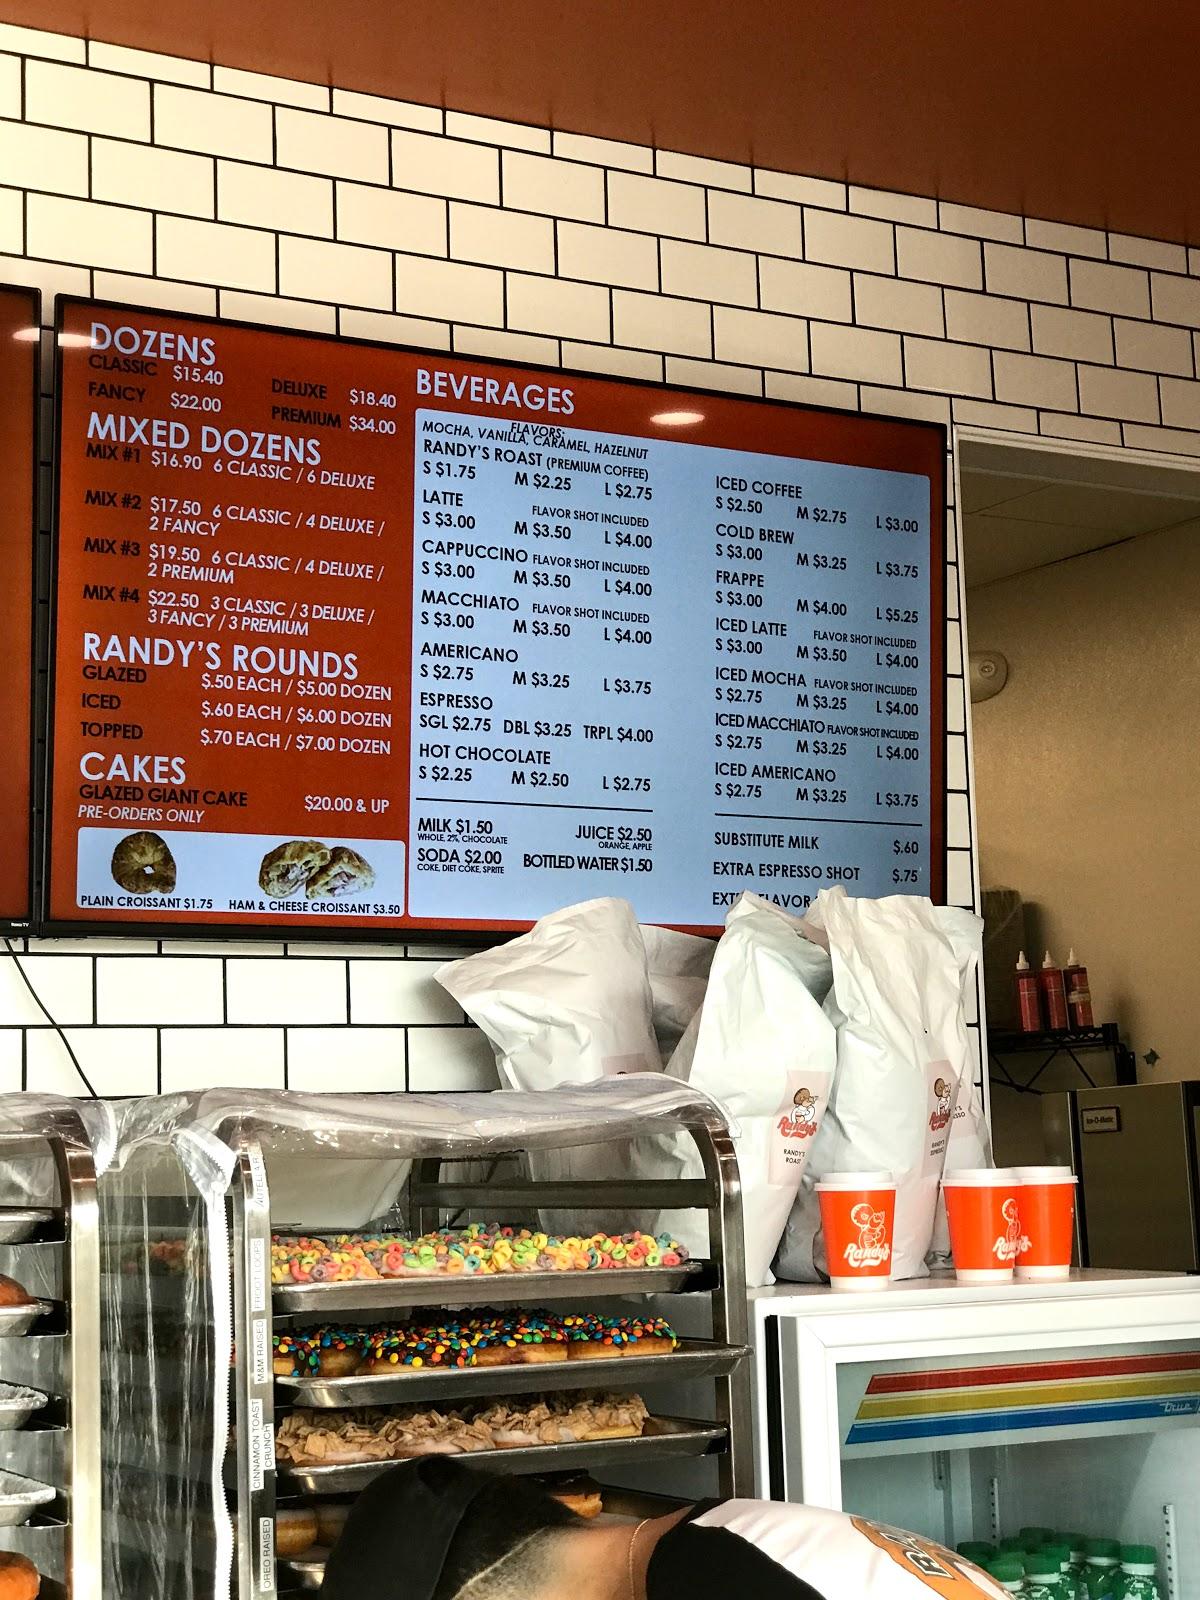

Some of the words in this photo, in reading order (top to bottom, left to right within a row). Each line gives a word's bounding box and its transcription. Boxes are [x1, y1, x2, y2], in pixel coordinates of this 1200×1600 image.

[90, 322, 215, 366] DOZENS
[89, 354, 159, 376] CLASSIC
[173, 365, 223, 385] $15.40
[89, 381, 146, 403] FANCY
[170, 392, 221, 412] $22.00
[272, 378, 327, 399] DELUXE
[350, 388, 396, 408] $18.40
[417, 369, 574, 414] BEVERAGES
[272, 405, 341, 428] PREMIUM
[349, 415, 396, 434] $34.00
[87, 412, 189, 449] MIXED
[201, 426, 321, 465] DOZENS
[422, 420, 473, 439] MOCHA,
[478, 428, 530, 446] VANILLA,
[533, 435, 590, 454] CARAMEL,
[594, 442, 648, 459] HAZELNUT
[511, 423, 566, 442] FLAVORS:
[86, 441, 119, 461] MIX
[122, 446, 140, 463] #1
[151, 450, 202, 470] $16.90
[213, 459, 223, 472] 6
[227, 460, 292, 480] CLASSIC
[296, 466, 304, 483] /
[307, 470, 316, 483] 6
[320, 471, 375, 490] DELUXE
[423, 460, 431, 474] S
[436, 461, 476, 479] $1.75
[424, 439, 490, 460] RANDY'S
[495, 448, 543, 466] ROAST
[546, 457, 601, 474] (PREMIUM
[604, 464, 648, 482] COFFEE)
[515, 471, 528, 486] M
[533, 473, 571, 491] $2.25
[605, 482, 611, 496] L
[616, 483, 652, 501] $2.75
[716, 476, 748, 492] ICED
[752, 481, 802, 499] COFFEE
[423, 489, 463, 507] LATTE
[716, 496, 723, 509] S
[727, 497, 762, 514] $2.50
[532, 505, 571, 519] FLAVOR
[574, 510, 599, 522] SHOT
[601, 513, 649, 528] INCLUDED
[796, 506, 809, 520] M
[813, 507, 847, 524] $2.75
[876, 515, 882, 529] L
[885, 516, 918, 533] $3.00
[716, 523, 754, 540] COLD
[759, 528, 794, 544] BREW
[422, 539, 528, 563] CAPPUCCINO
[716, 570, 764, 588] FRAPPE
[421, 589, 519, 611] MACCHIATO
[716, 617, 748, 633] ICED
[752, 621, 787, 637] LATTE
[84, 632, 221, 670] RANDY'S
[233, 645, 358, 680] ROUNDS
[420, 642, 518, 663] AMERICANO
[82, 663, 147, 683] GLAZED
[201, 672, 233, 690] $.50
[237, 676, 281, 693] EACH
[286, 680, 293, 695] /
[297, 679, 337, 696] $5.00
[340, 683, 391, 700] DOZEN
[716, 666, 747, 682] ICED
[751, 670, 807, 687] MOCHA
[420, 692, 493, 710] ESPRESSO
[80, 721, 143, 740] TOPPED
[200, 728, 232, 746] $.70
[236, 731, 280, 748] EACH
[285, 735, 292, 750] /
[296, 734, 335, 751] $7.00
[340, 738, 390, 755] DOZEN
[419, 714, 448, 729] SGL
[452, 715, 491, 732] $2.75
[504, 719, 530, 735] DBL
[534, 721, 571, 738] $3.25
[583, 725, 613, 740] TRPL
[617, 726, 653, 743] $4.00
[715, 713, 744, 727] ICED
[747, 715, 825, 733] MACCHIATO
[827, 725, 858, 736] FLAVOR
[859, 727, 880, 738] SHOT
[881, 729, 919, 740] INCLUDED
[420, 743, 451, 759] HOT
[455, 746, 550, 765] CHOCOLATE
[80, 752, 186, 785] CAKES
[715, 762, 747, 777] ICED
[751, 765, 836, 782] AMERICANO
[79, 784, 144, 801] GLAZED
[148, 788, 200, 804] GIANT
[202, 790, 248, 807] CAKE
[304, 795, 353, 812] $20.00
[356, 799, 367, 812] &
[371, 799, 389, 813] UP
[78, 805, 163, 821] PRE-ORDERS
[166, 809, 205, 823] ONLY
[418, 817, 452, 833] MILK
[455, 818, 493, 835] $1.50
[575, 825, 614, 840] JUICE
[618, 826, 652, 842] $2.50
[417, 833, 445, 842] WHOLE,
[462, 835, 508, 844] CHOCOLATE
[598, 842, 631, 851] ORANGE,
[632, 843, 652, 851] APPLE
[714, 832, 784, 848] SUBSTITUTE
[788, 835, 819, 850] MILK
[893, 839, 919, 855] $.60
[417, 848, 460, 863] SODA
[464, 850, 502, 864] $2.00
[523, 854, 575, 869] BOTTLED
[577, 856, 619, 871] WATER
[620, 857, 653, 873] $1.50
[417, 863, 440, 872] COKE,
[442, 864, 457, 872] DIET
[482, 866, 504, 874] SPRITE
[713, 861, 755, 876] EXTRA
[759, 863, 822, 879] ESPRESSO
[826, 866, 860, 880] SHOT
[892, 868, 918, 884] $.75
[81, 895, 113, 906] PLAIN
[117, 897, 181, 908] CROISSANT
[184, 898, 213, 910] $1.75
[229, 900, 255, 910] HAM
[258, 901, 265, 910] &
[269, 901, 308, 911] CHEESE
[311, 902, 371, 913] CROISSANT
[373, 904, 400, 915] $3.50
[843, 1242, 891, 1268] Randy's
[251, 1400, 260, 1432] TOAST
[263, 1425, 272, 1468] CRUNCH
[252, 1435, 261, 1489] CINNAMON
[262, 1519, 271, 1557] RAISED
[262, 1559, 271, 1589] OREO
